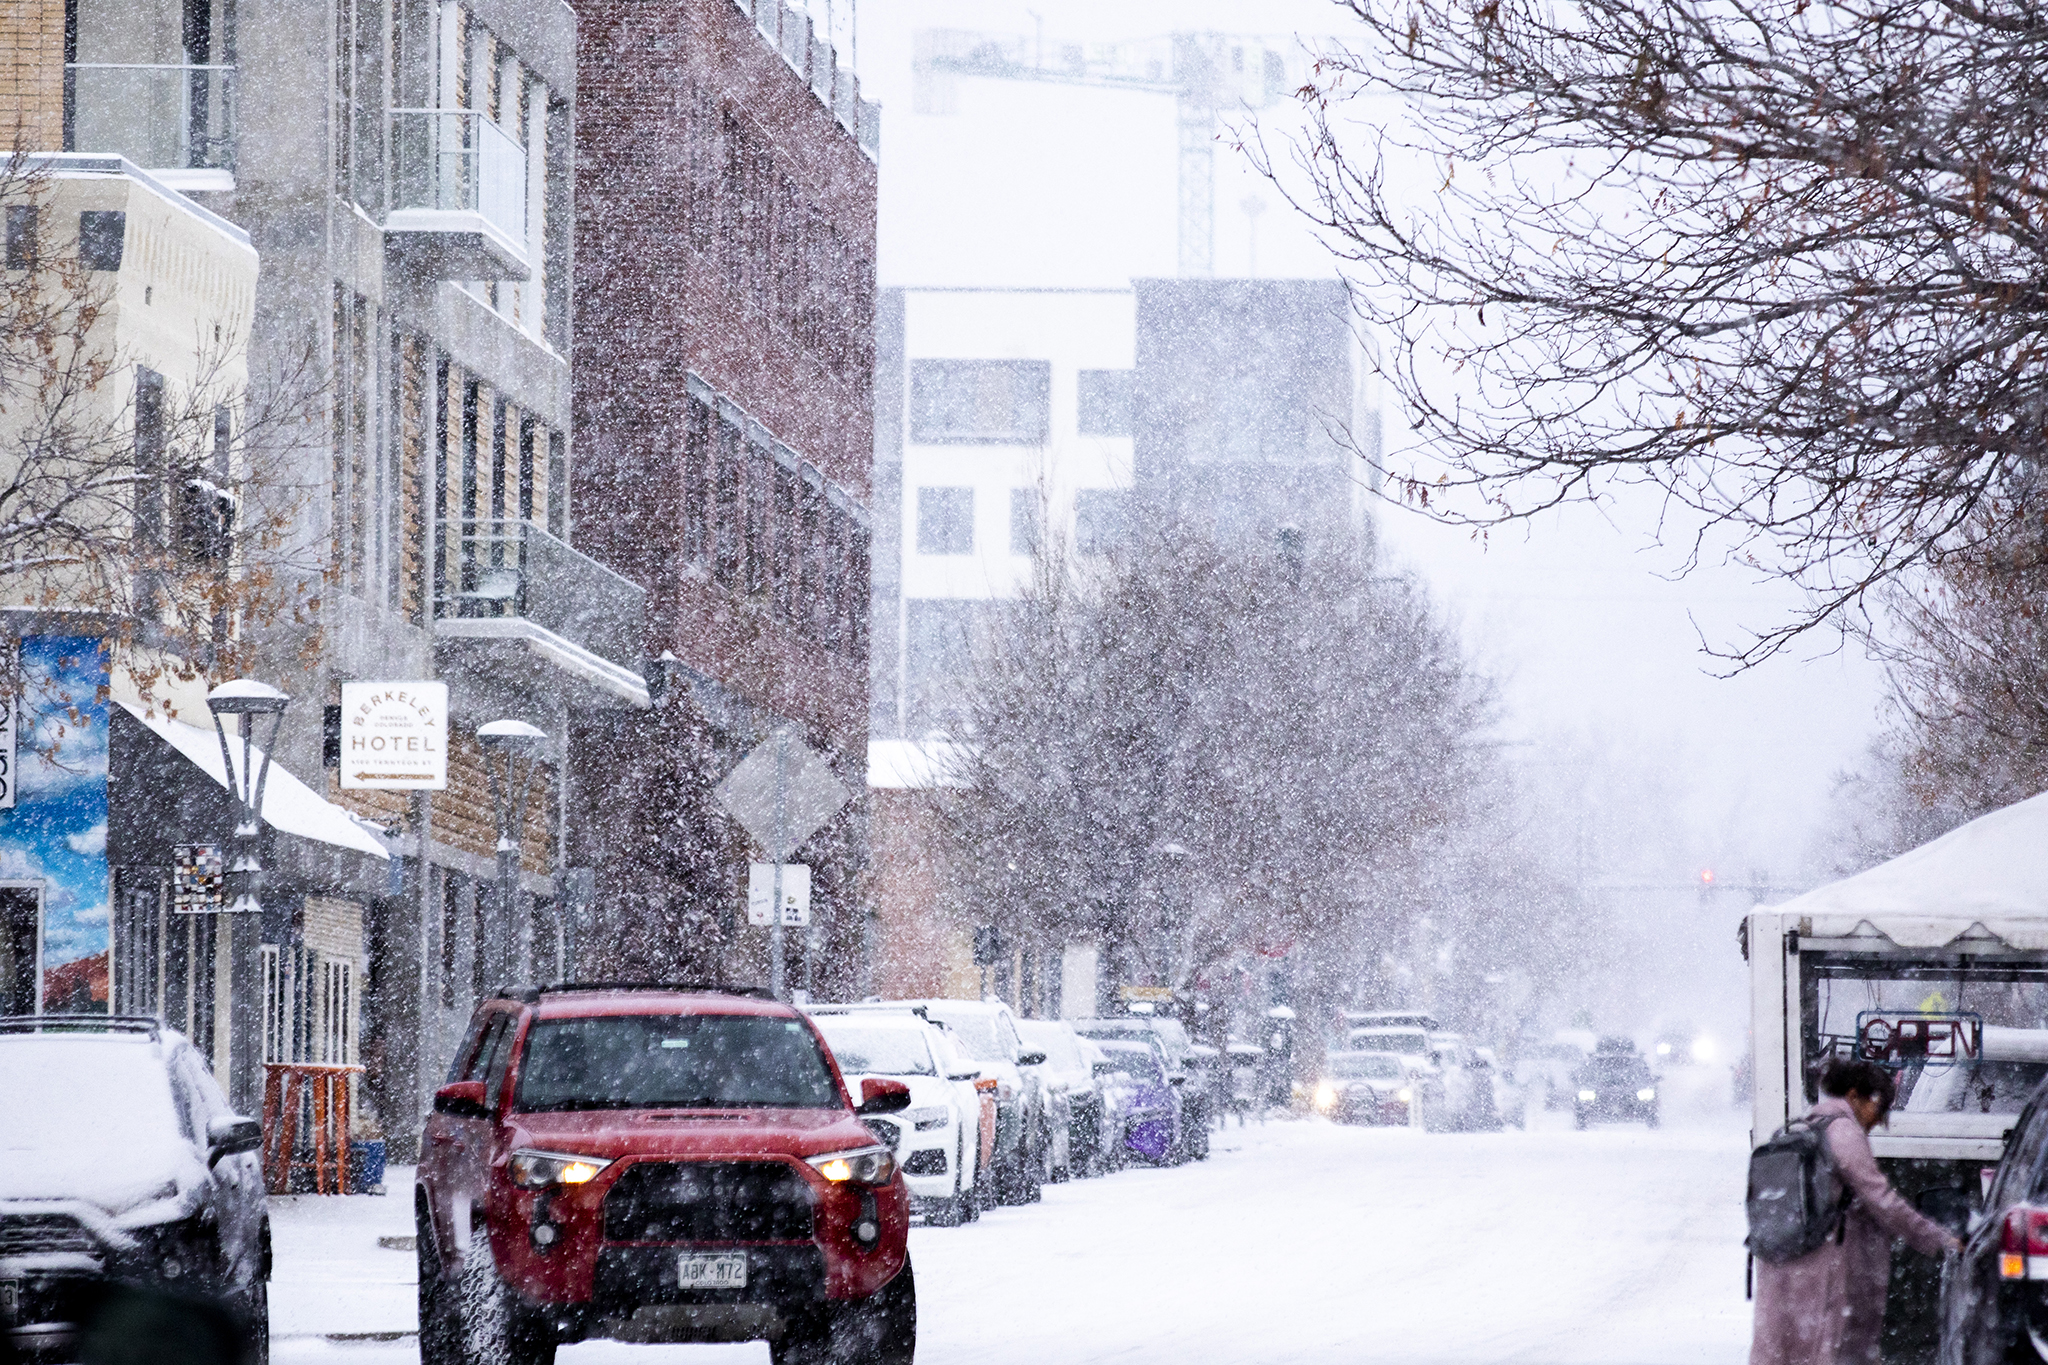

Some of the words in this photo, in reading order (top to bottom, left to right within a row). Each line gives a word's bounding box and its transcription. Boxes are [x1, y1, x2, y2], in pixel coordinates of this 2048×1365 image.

[353, 690, 435, 727] BERKELEY
[352, 735, 436, 752] HOTEL
[1865, 1018, 1976, 1059] OPEN
[678, 1185, 749, 1198] OYOTA
